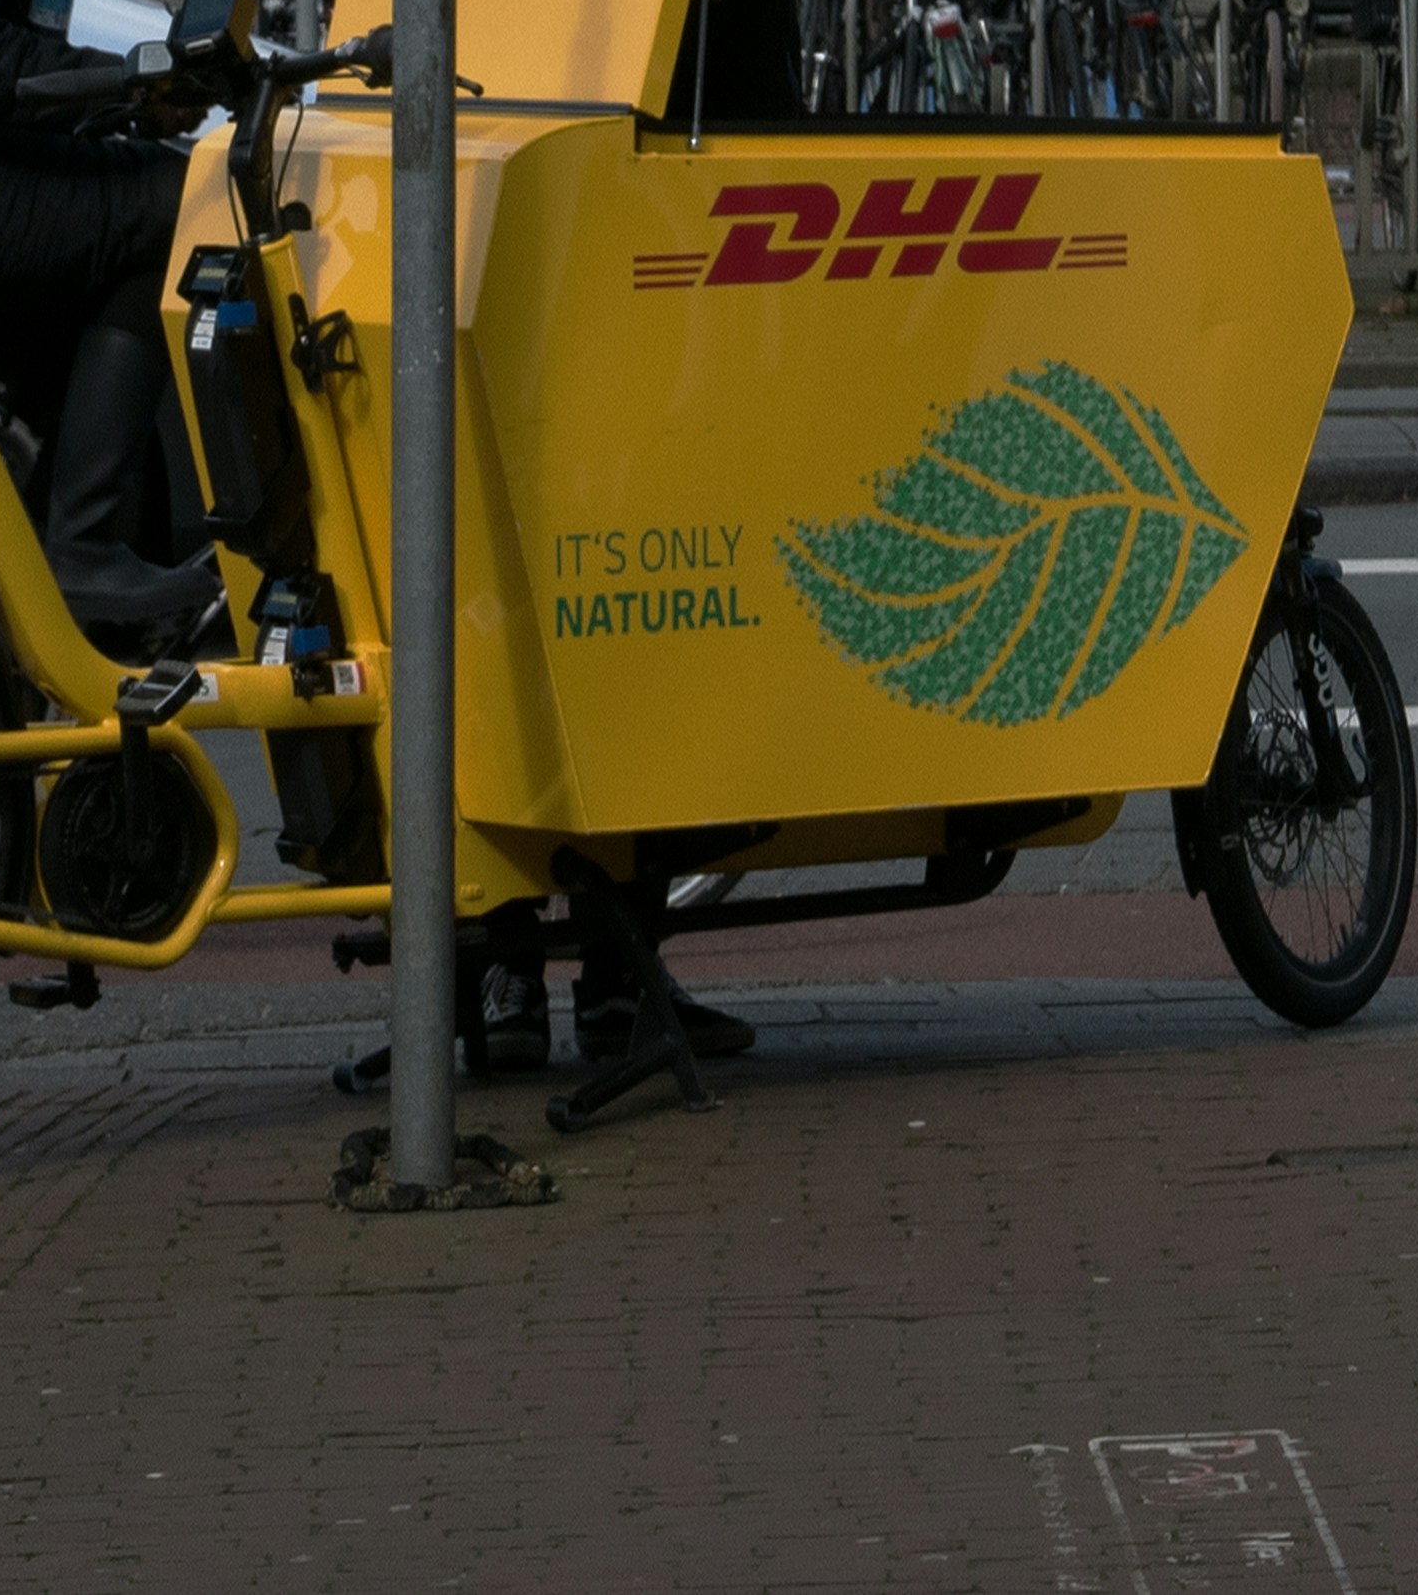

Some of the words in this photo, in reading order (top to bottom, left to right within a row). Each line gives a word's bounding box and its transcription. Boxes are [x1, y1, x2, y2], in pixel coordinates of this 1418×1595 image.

[703, 173, 1063, 286] DHL
[639, 524, 744, 575] ONLY
[555, 585, 762, 641] NATURAL.
